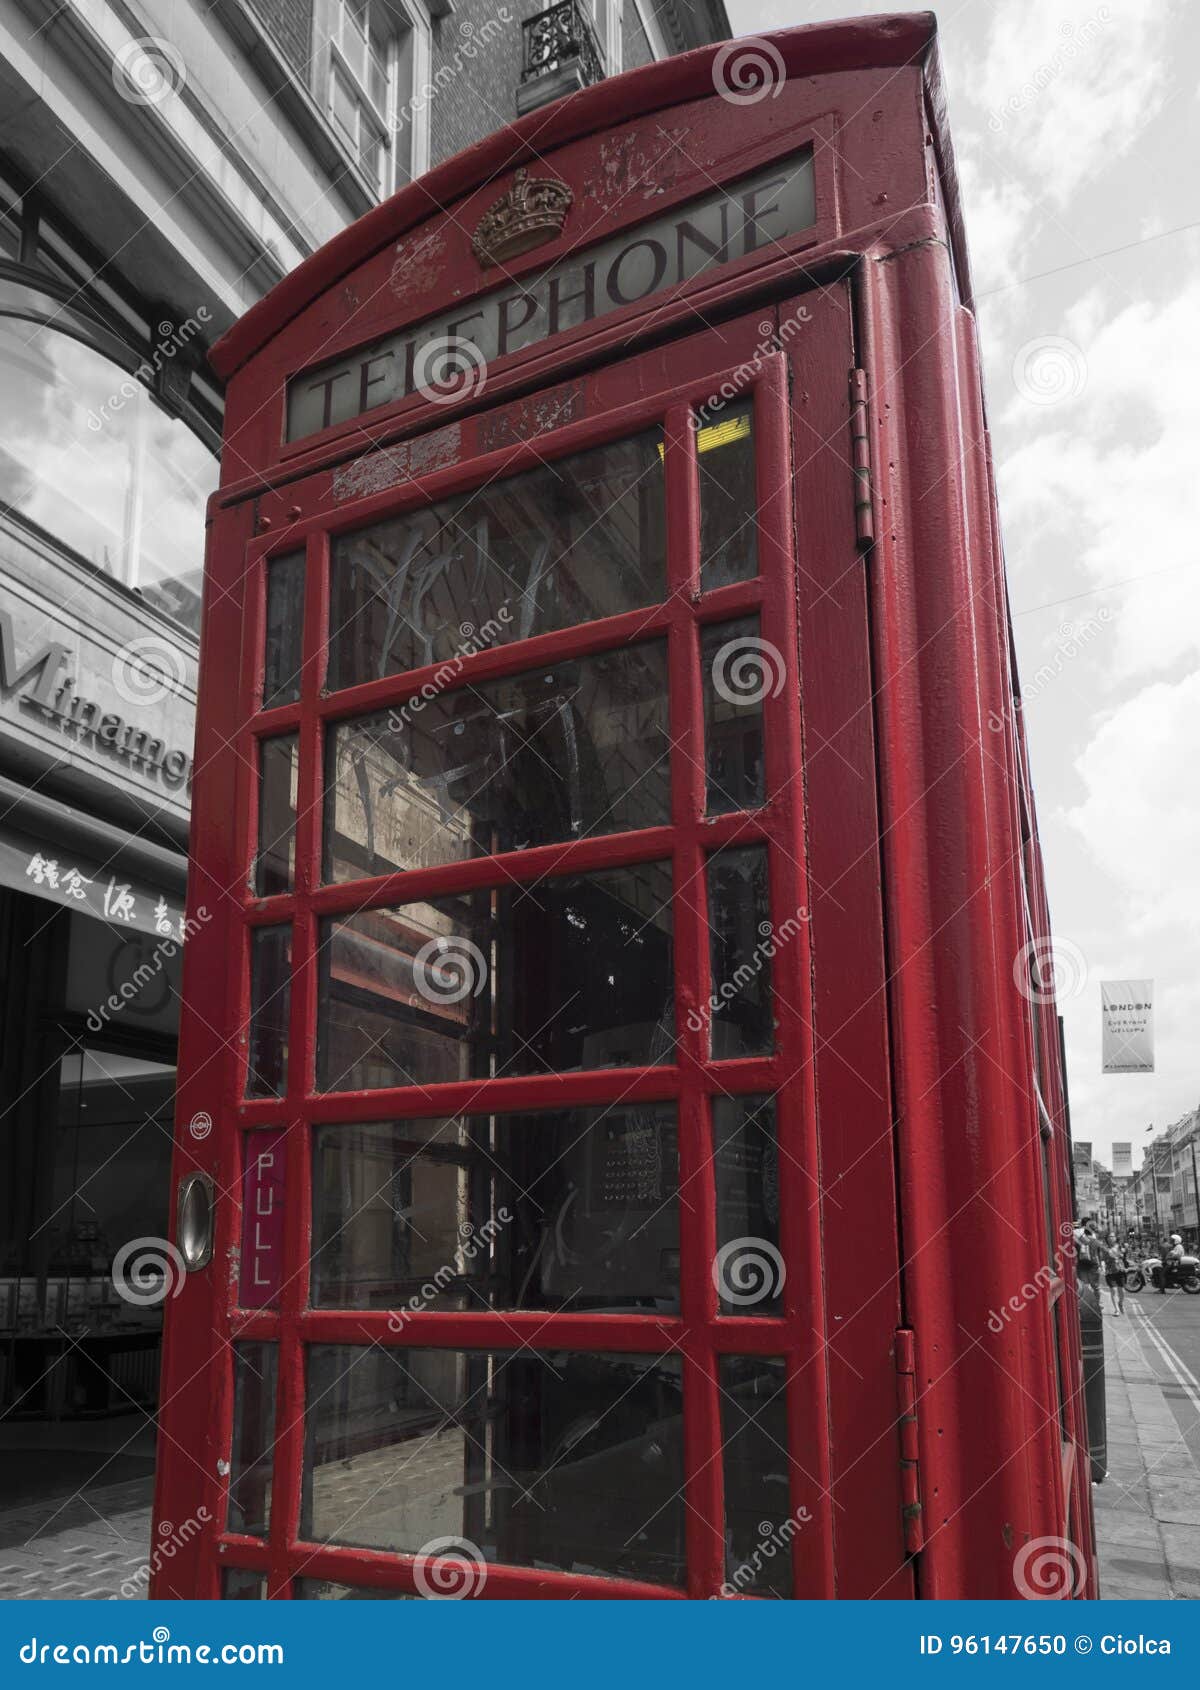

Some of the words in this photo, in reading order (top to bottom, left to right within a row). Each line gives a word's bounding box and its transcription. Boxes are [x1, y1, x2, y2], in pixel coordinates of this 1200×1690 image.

[308, 176, 789, 430] TELEPHONE
[0, 609, 193, 796] Minamo
[1103, 1002, 1152, 1012] LONDON
[254, 1153, 275, 1285] PULL
